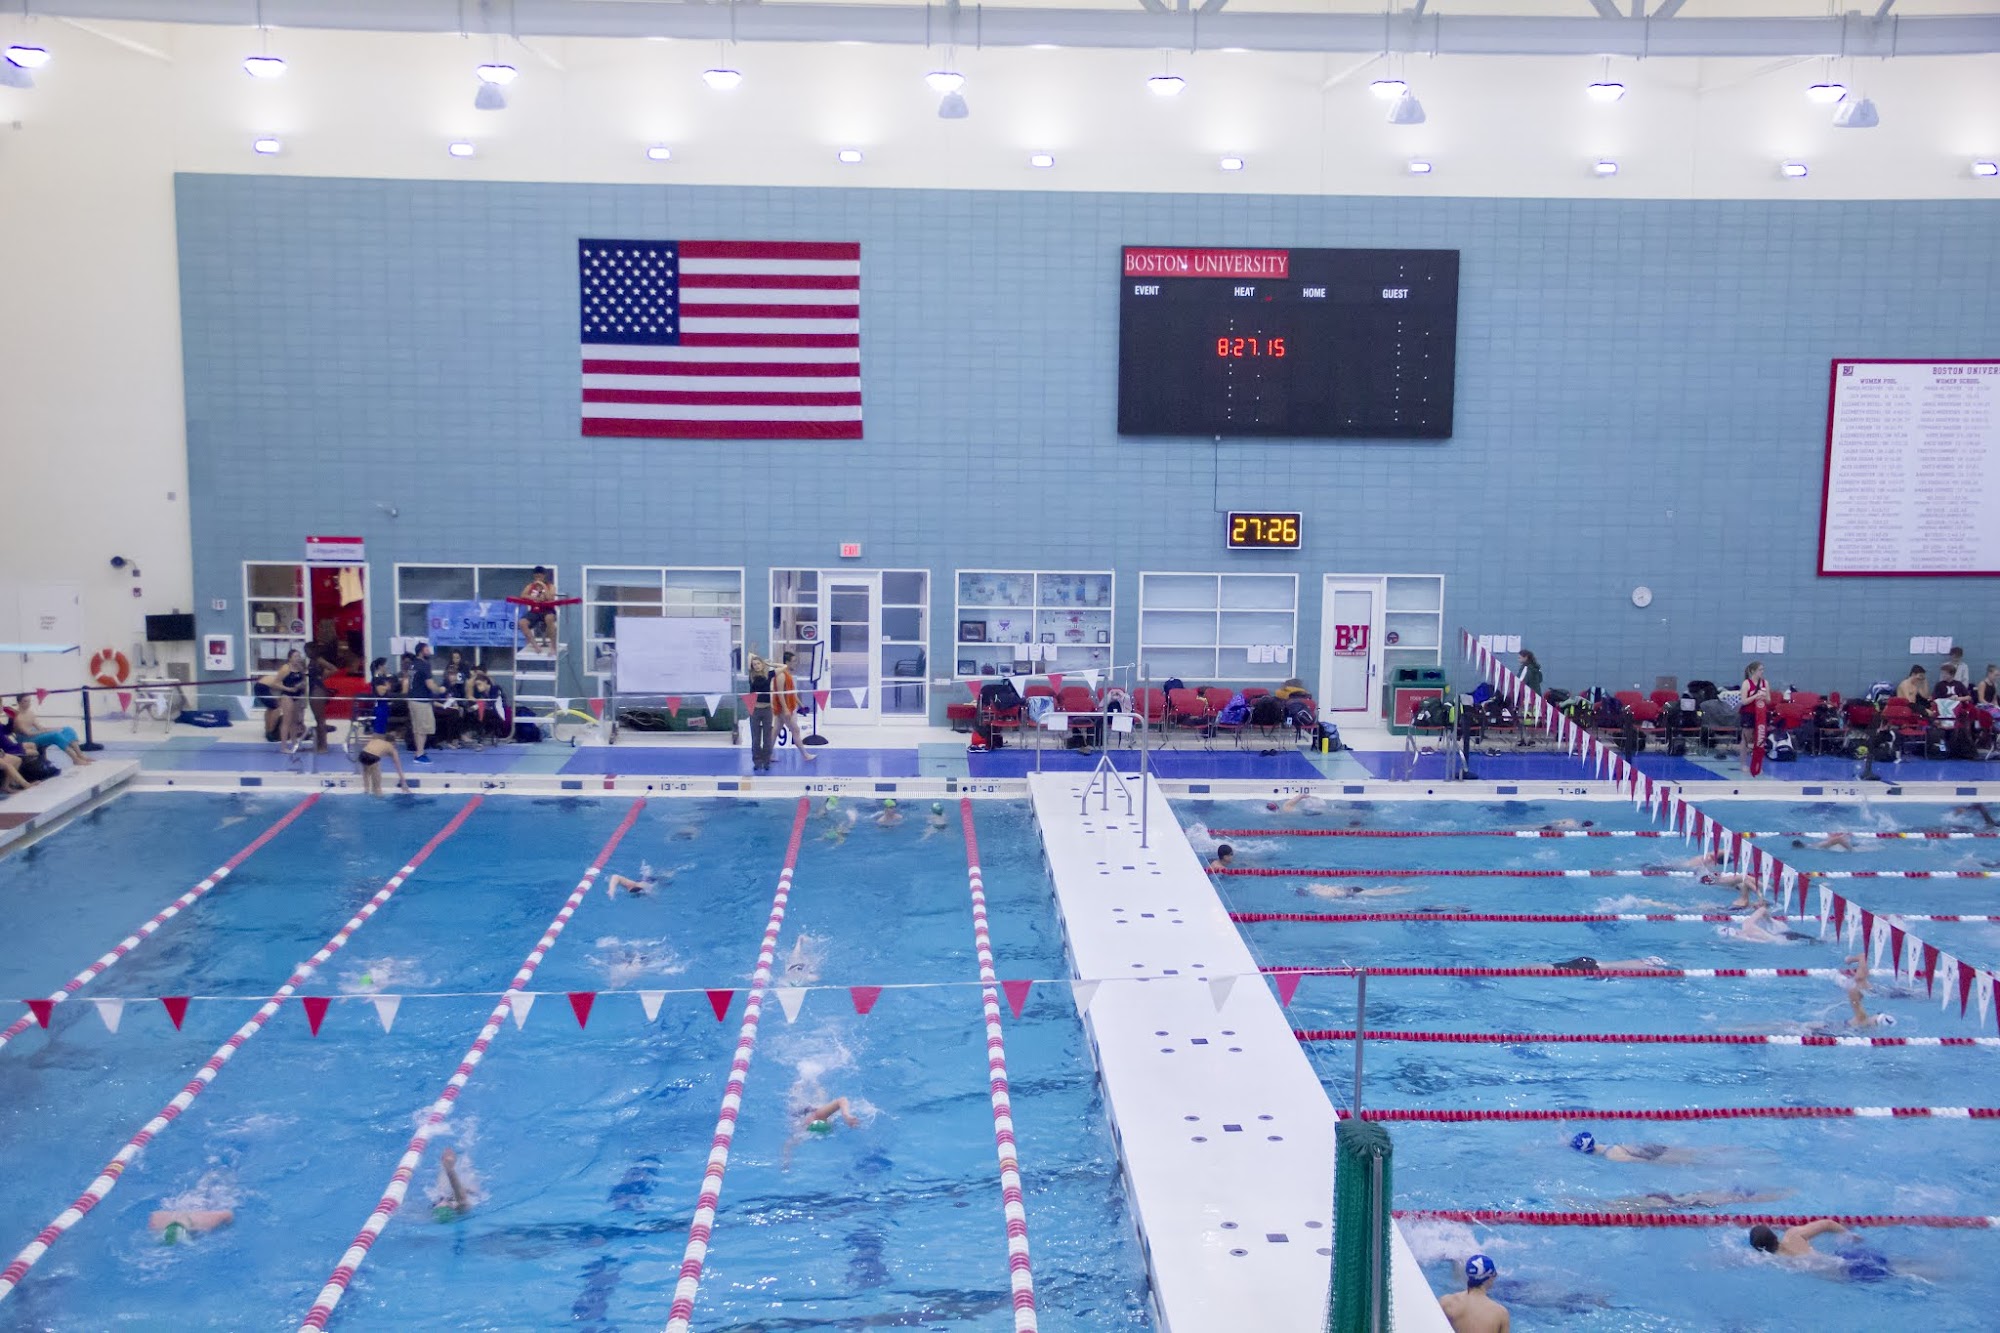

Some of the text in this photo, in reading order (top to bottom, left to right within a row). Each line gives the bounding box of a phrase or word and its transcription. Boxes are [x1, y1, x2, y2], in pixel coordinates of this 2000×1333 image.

[1126, 254, 1287, 274] BOSTON UNIVERSITY
[1134, 286, 1160, 296] EVENT
[1234, 287, 1255, 297] HEAT
[1303, 288, 1326, 298] HOME
[1382, 289, 1409, 299] GUEST
[1932, 366, 2000, 375] BOSTON UNIVER
[1233, 518, 1297, 542] 27:26
[843, 544, 859, 556] EXIT
[463, 618, 497, 630] Swim
[1335, 625, 1370, 650] BU
